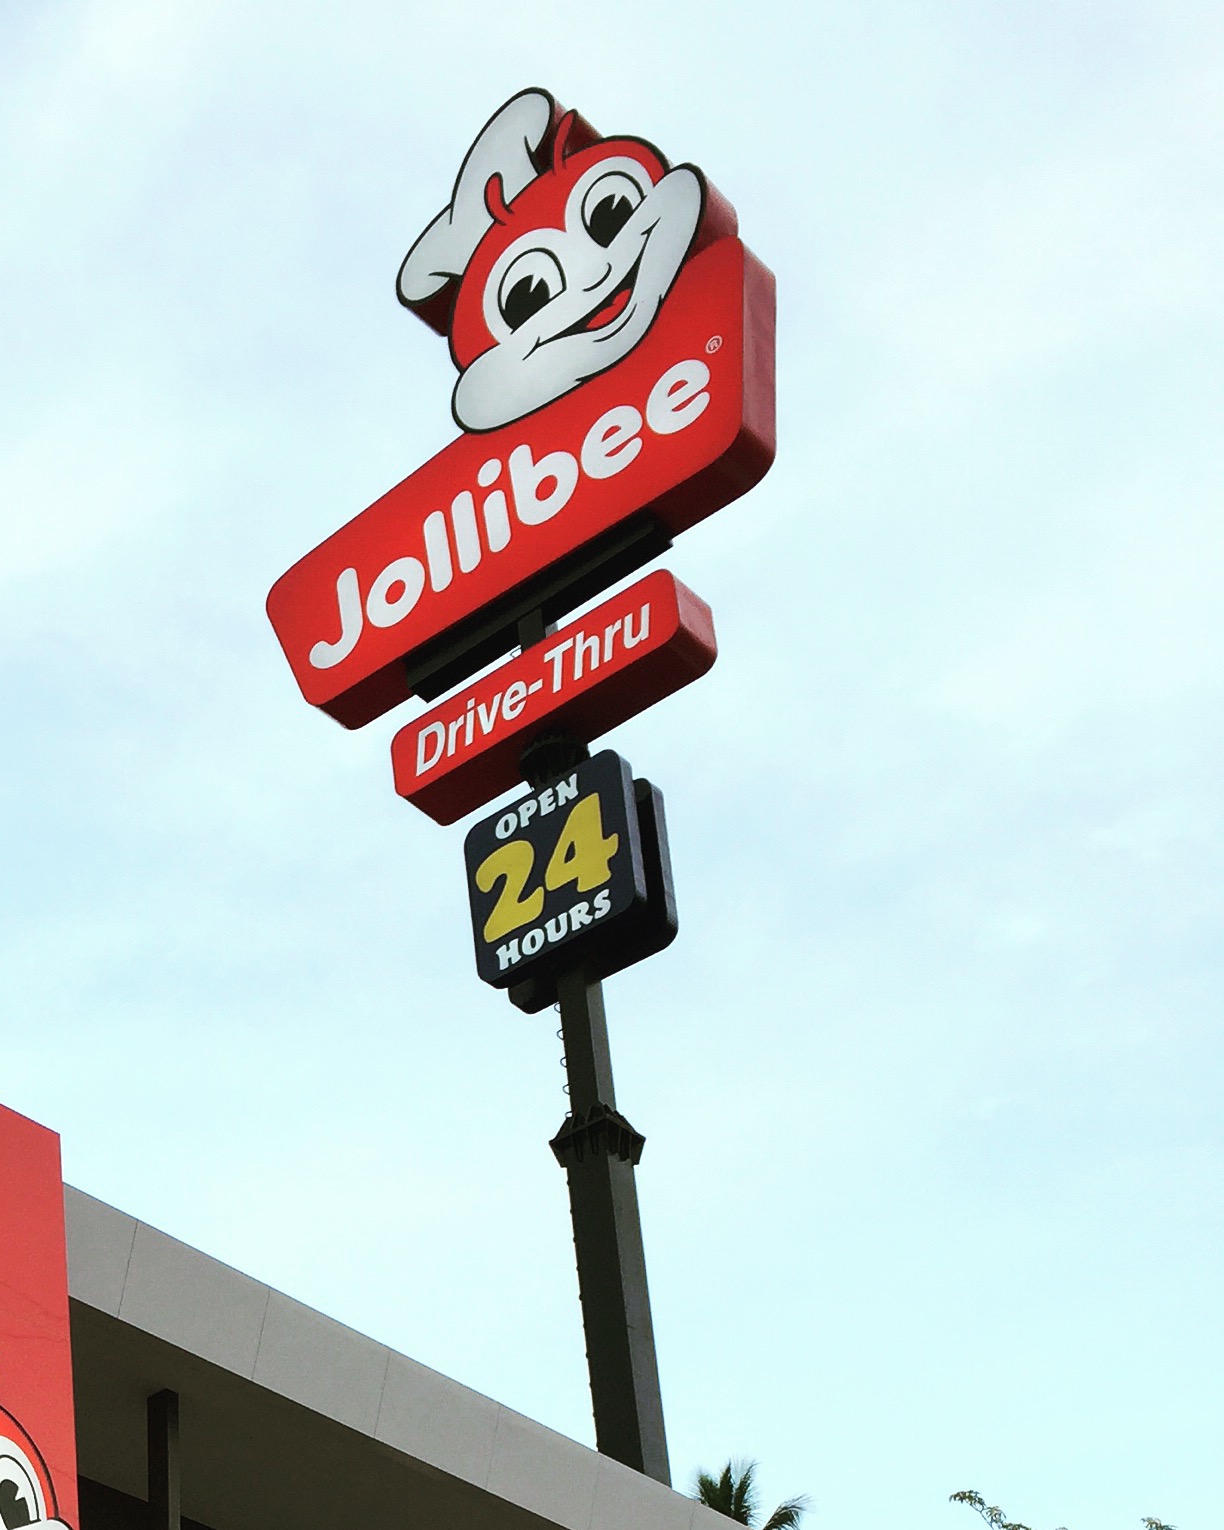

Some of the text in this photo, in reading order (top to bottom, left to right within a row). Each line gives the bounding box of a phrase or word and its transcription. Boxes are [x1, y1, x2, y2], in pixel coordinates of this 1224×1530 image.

[309, 359, 711, 670] Jollibee
[414, 602, 651, 777] Drive-Thru
[476, 793, 619, 943] 24
[495, 773, 580, 840] OPEN
[496, 889, 612, 970] HOURS
